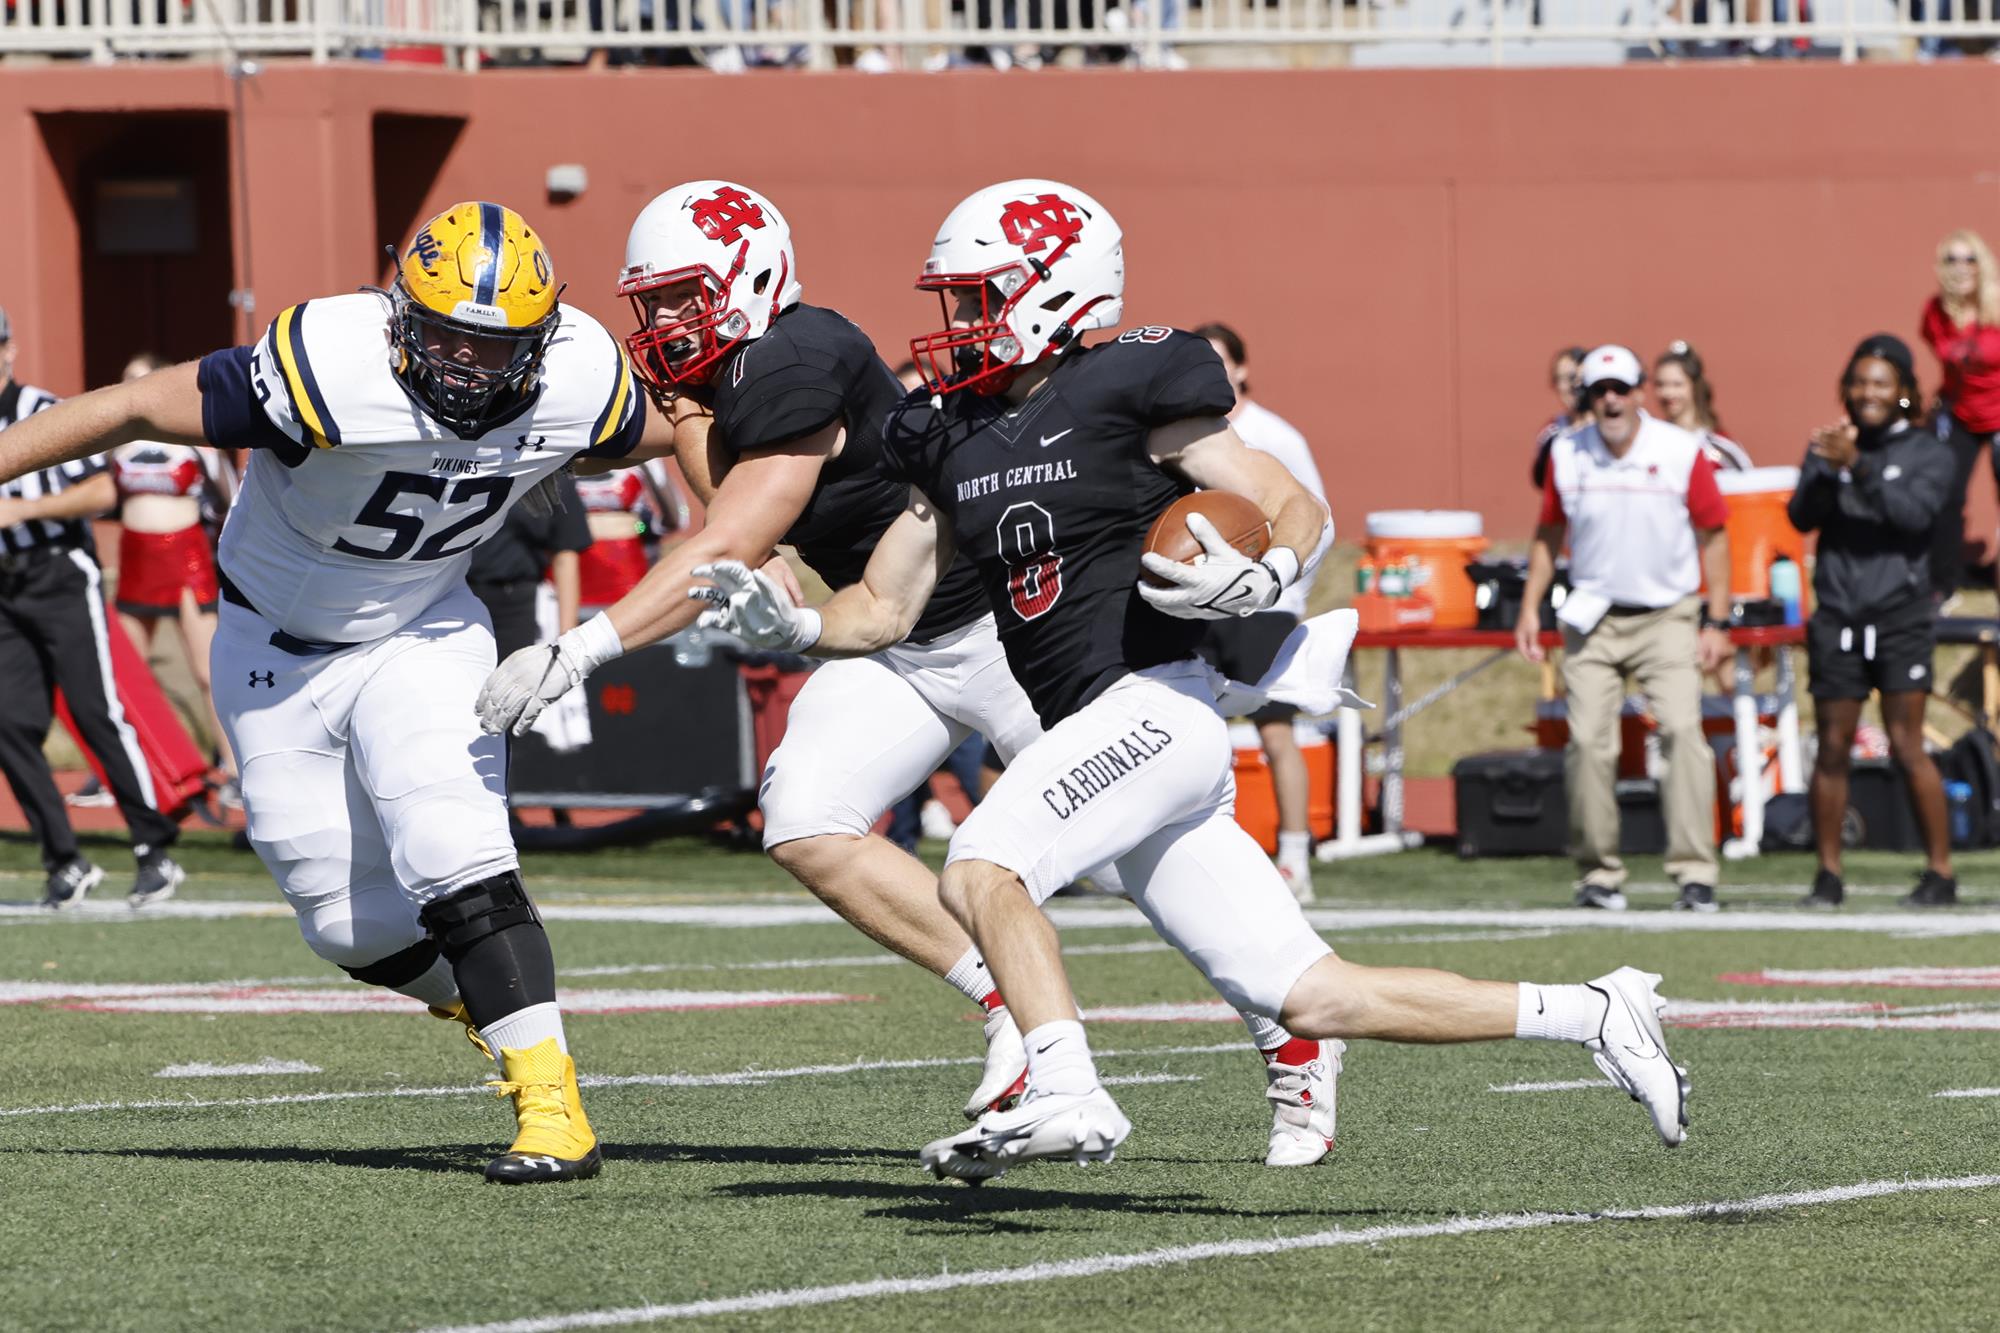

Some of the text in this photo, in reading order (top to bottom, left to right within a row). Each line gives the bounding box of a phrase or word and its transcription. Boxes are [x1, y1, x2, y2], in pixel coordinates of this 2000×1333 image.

[1118, 325, 1174, 344] 8
[432, 457, 481, 475] VIKINGS
[956, 459, 1078, 502] NORTH CENTRAL
[331, 470, 515, 561] 52
[996, 501, 1063, 622] 8
[1042, 719, 1172, 820] CARDINALS
